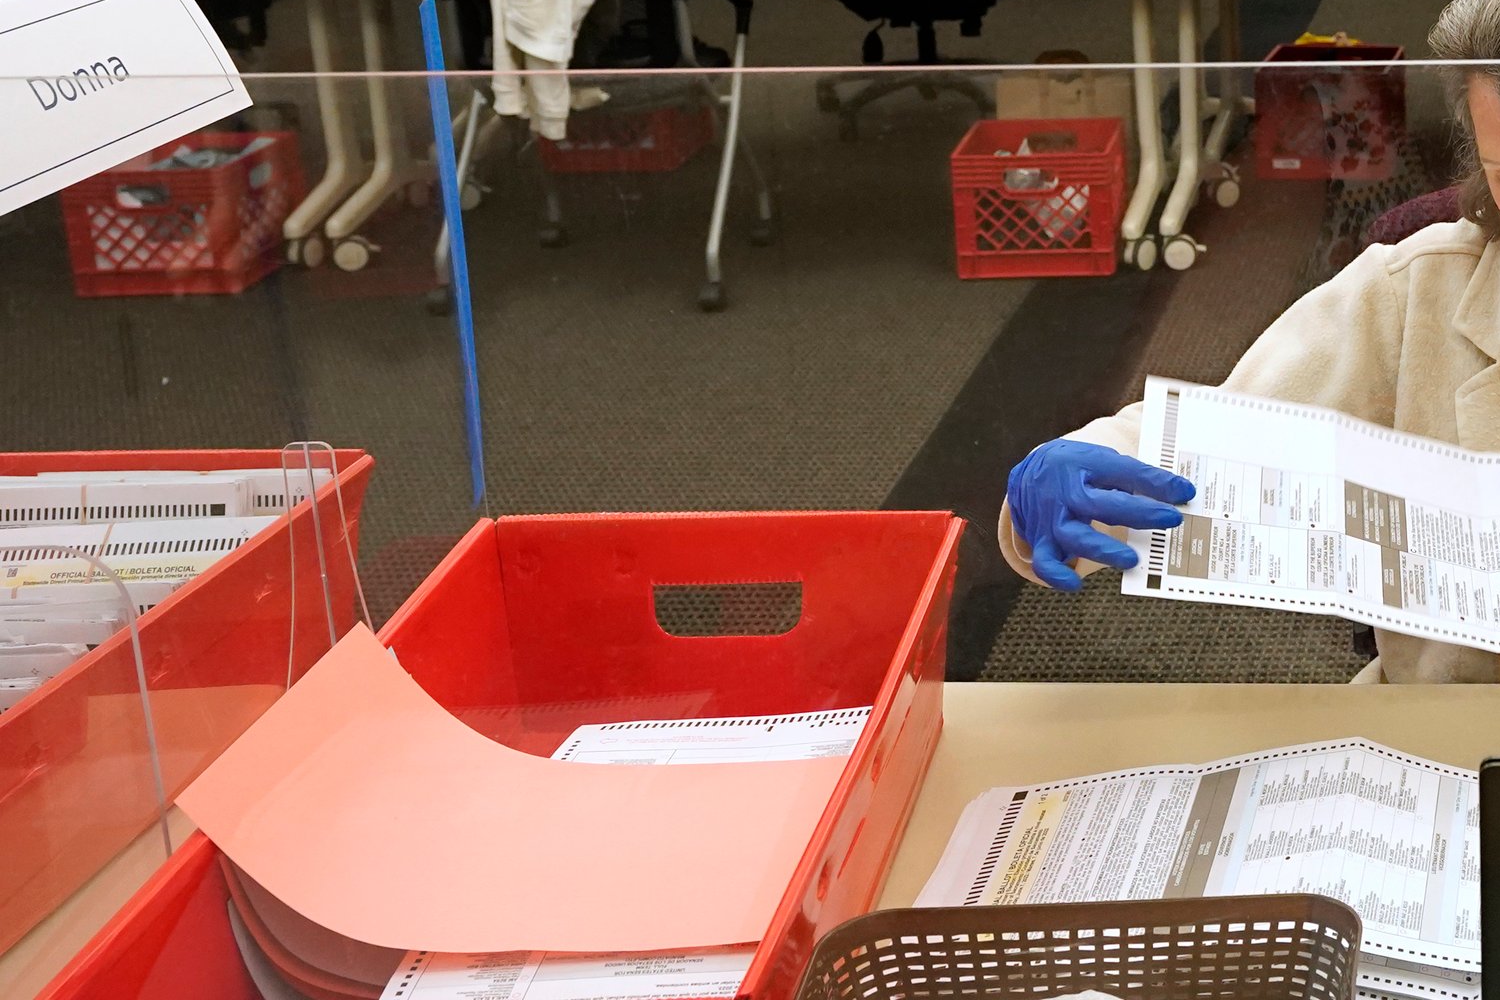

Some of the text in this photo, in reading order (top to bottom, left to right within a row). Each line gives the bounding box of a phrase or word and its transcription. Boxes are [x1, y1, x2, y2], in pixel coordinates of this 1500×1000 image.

[26, 56, 130, 111] Donna
[50, 571, 87, 580] OFFICIAL
[90, 569, 123, 578] BALOT
[129, 567, 162, 575] BOLETA
[164, 565, 196, 573] OFICIAL
[997, 873, 1013, 896] BALLOT
[1008, 847, 1024, 871] BOLETA
[1018, 825, 1034, 849] OFICIAL
